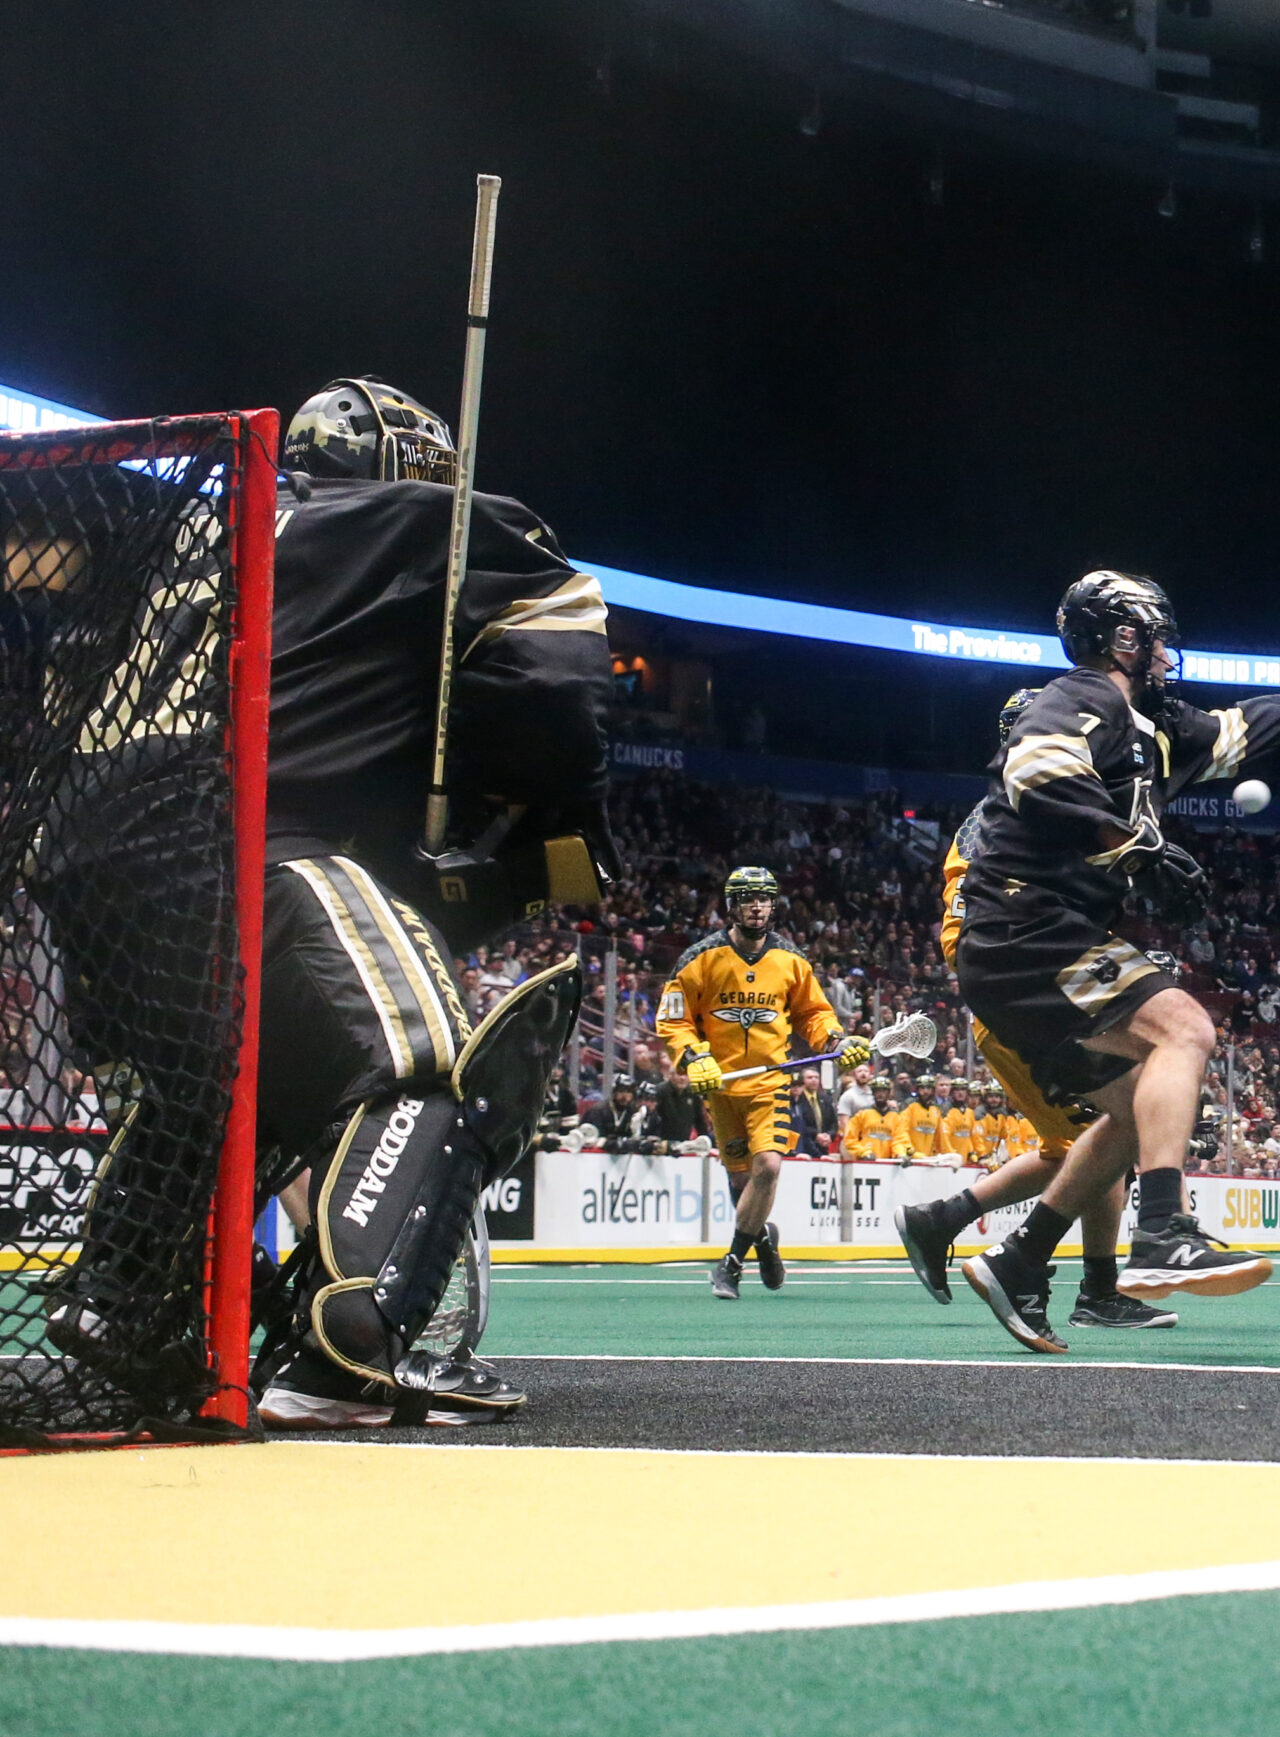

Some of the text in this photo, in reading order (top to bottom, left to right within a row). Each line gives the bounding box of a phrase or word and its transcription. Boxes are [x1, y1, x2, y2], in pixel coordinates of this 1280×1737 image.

[912, 624, 1042, 662] The Province
[1185, 656, 1250, 682] PROUD
[1076, 712, 1101, 735] 7
[1164, 797, 1218, 818] NUCKS
[720, 991, 778, 1006] GEORGIA
[342, 1098, 425, 1228] BODDAM
[810, 1176, 882, 1211] GAIT
